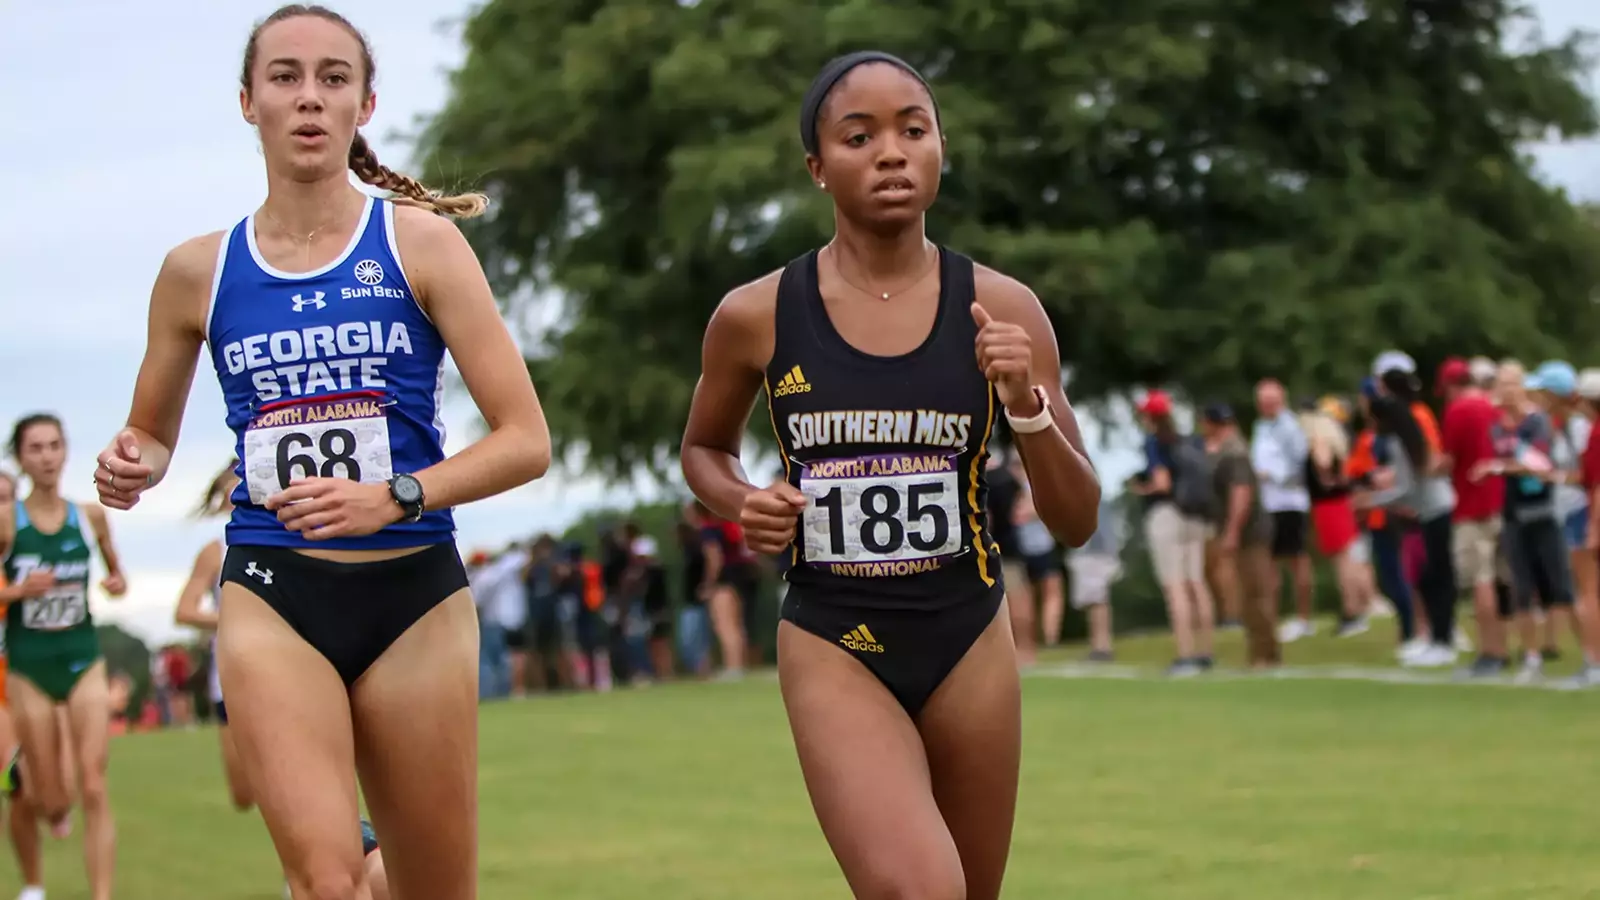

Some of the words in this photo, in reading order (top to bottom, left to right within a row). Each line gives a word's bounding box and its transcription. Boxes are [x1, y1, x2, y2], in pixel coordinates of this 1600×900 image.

[341, 287, 371, 299] SUN
[373, 285, 405, 299] BELT
[223, 320, 413, 376] GEORGIA
[252, 357, 387, 401] STATE
[774, 383, 811, 398] adidas
[306, 401, 381, 422] ALABAMA
[788, 410, 913, 450] SOUTHERN
[914, 409, 971, 447] MISS
[276, 428, 361, 491] 68
[810, 460, 866, 478] NORTH
[870, 455, 951, 475] ALABAMA
[815, 482, 949, 555] 185
[831, 558, 940, 577] INVITATIONAL
